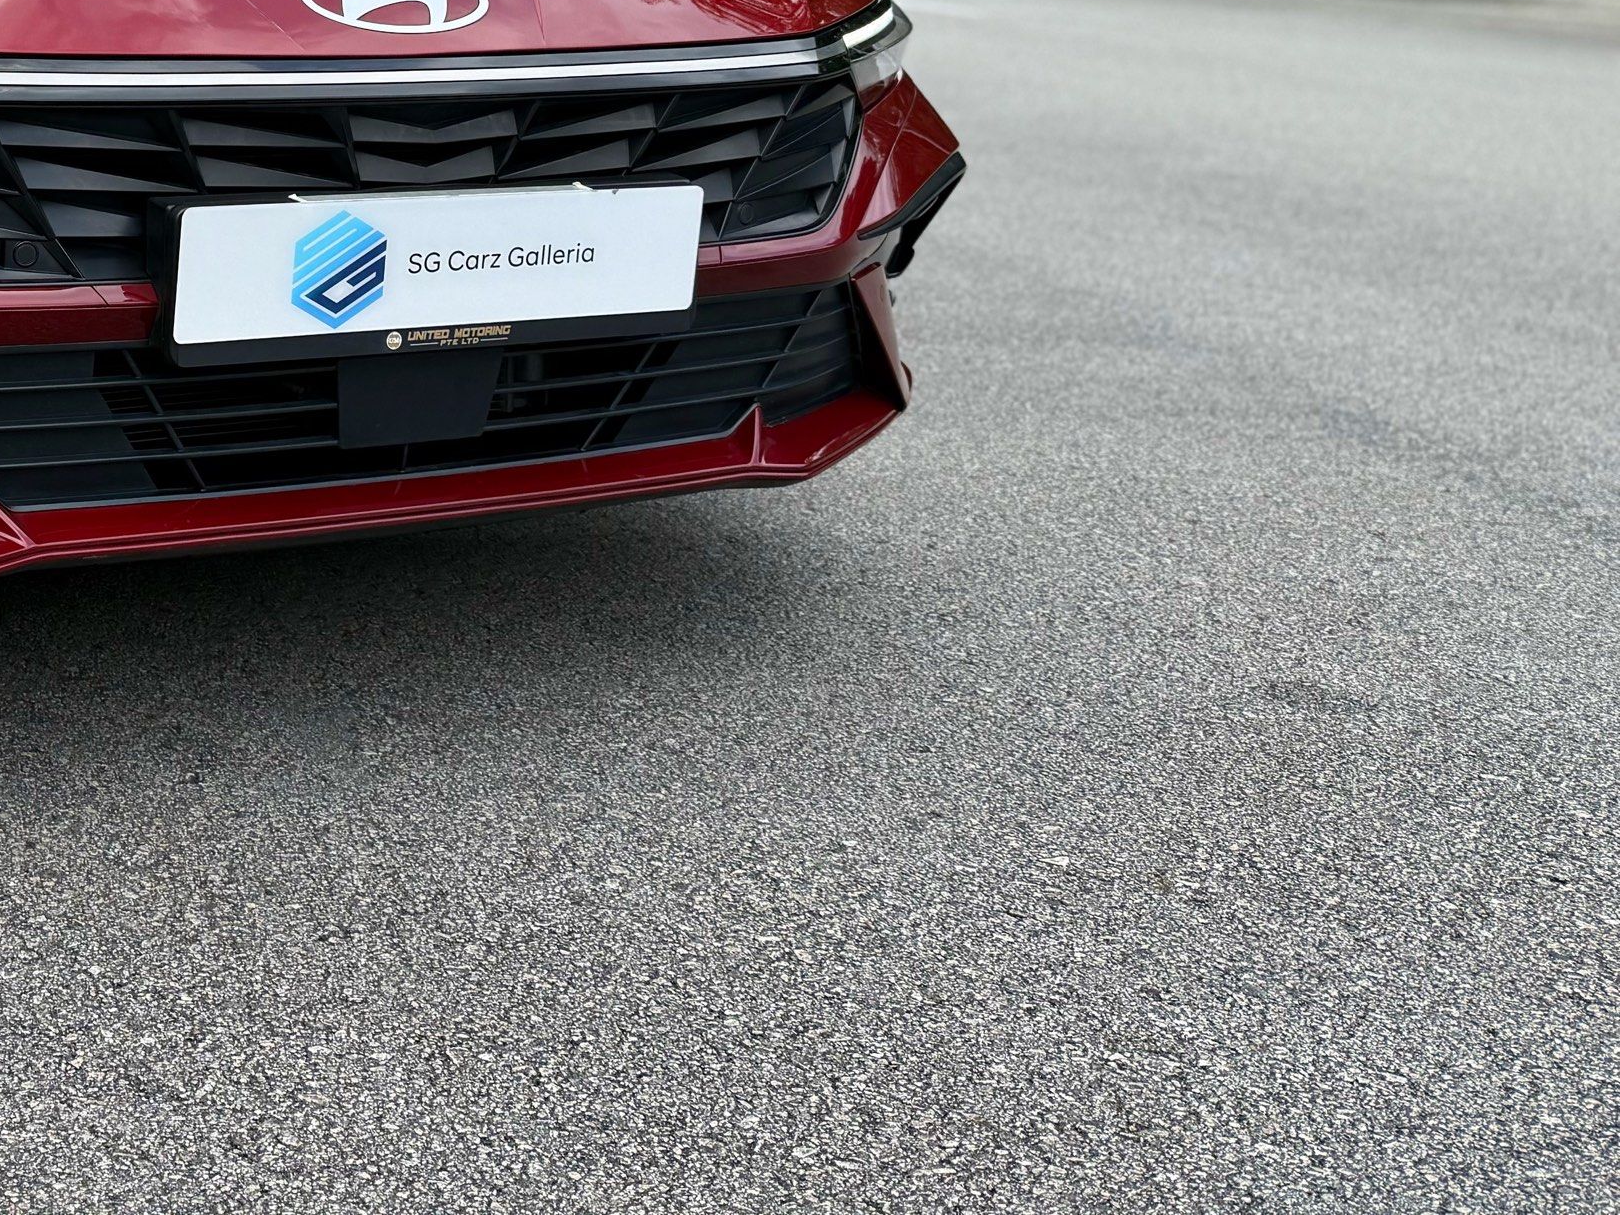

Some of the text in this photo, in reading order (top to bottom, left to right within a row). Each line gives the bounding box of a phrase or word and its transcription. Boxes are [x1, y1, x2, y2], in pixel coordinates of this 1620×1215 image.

[408, 243, 595, 274] SG Carz Galleria
[407, 328, 450, 341] UNITED
[454, 325, 511, 338] MOTORING
[461, 337, 479, 345] LTD
